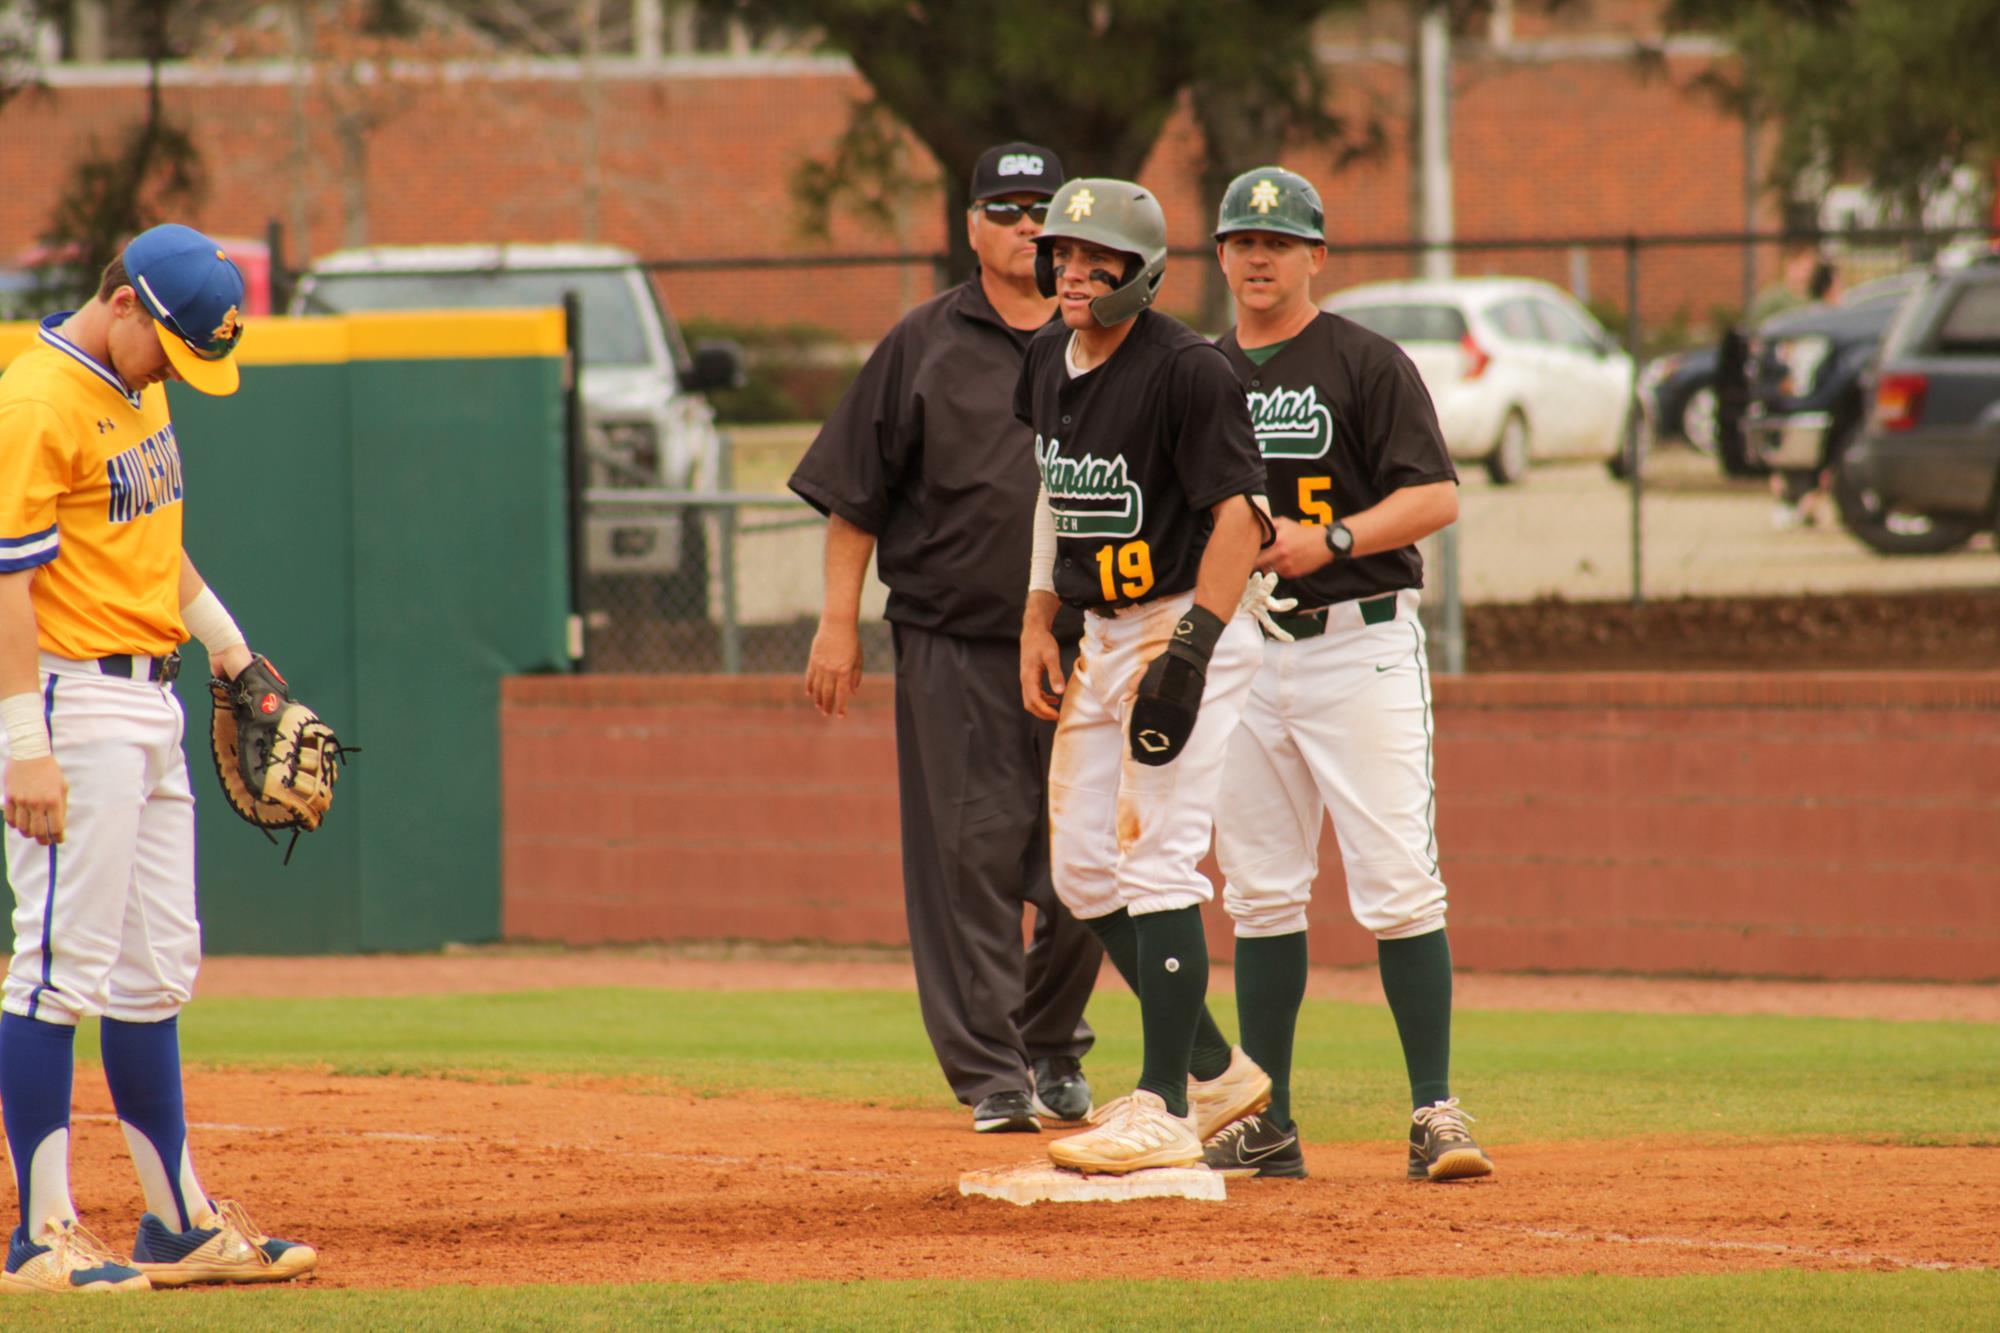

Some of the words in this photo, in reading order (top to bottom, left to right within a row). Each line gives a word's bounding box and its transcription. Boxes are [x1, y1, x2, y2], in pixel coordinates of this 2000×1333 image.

[1055, 516, 1078, 531] ECH
[1298, 476, 1333, 526] 5
[1096, 539, 1155, 601] 19
